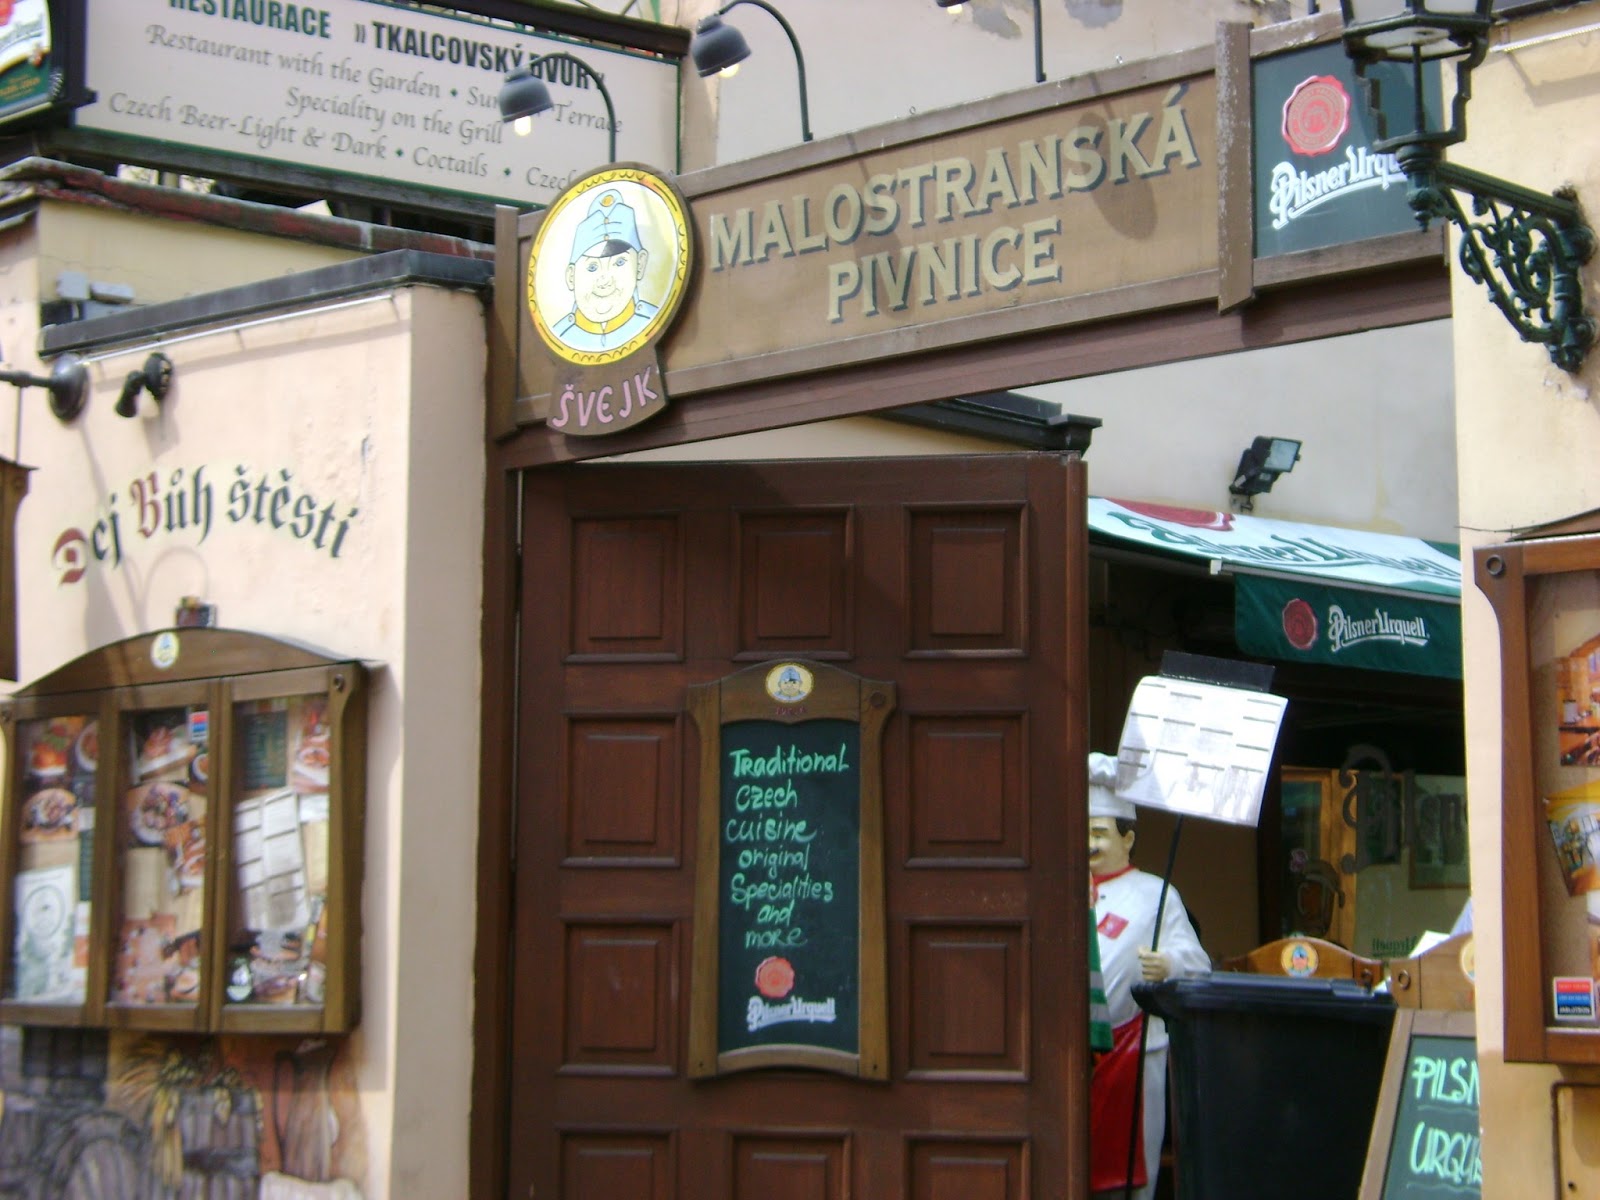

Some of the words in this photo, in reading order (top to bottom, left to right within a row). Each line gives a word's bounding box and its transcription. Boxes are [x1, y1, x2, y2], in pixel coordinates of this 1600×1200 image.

[168, 0, 332, 39] STAURACE
[145, 24, 272, 66] Restaurant
[277, 51, 324, 77] with
[331, 57, 362, 83] the
[368, 67, 441, 98] Garden
[108, 92, 172, 122] Czech
[178, 104, 297, 149] Beer-Light
[331, 132, 388, 160] Dark
[413, 147, 489, 177] Coctails
[285, 87, 387, 132] Speciality
[392, 111, 416, 129] on
[423, 110, 451, 135] the
[459, 119, 504, 145] Grill
[708, 83, 1200, 271] MALOSTRANSKÁ
[1269, 160, 1354, 230] Pilsner
[1345, 144, 1403, 191] Urqu
[826, 216, 1062, 324] PIVNICE
[551, 366, 658, 428] ŠVEJK
[129, 464, 214, 545] Bůh
[227, 463, 360, 559] štěstí
[1328, 604, 1377, 652] Pilsner
[1375, 607, 1426, 646] Urquell
[738, 843, 810, 879] original
[757, 899, 795, 925] and
[1412, 1055, 1480, 1105] PILSN
[1410, 1121, 1482, 1185] URQU
